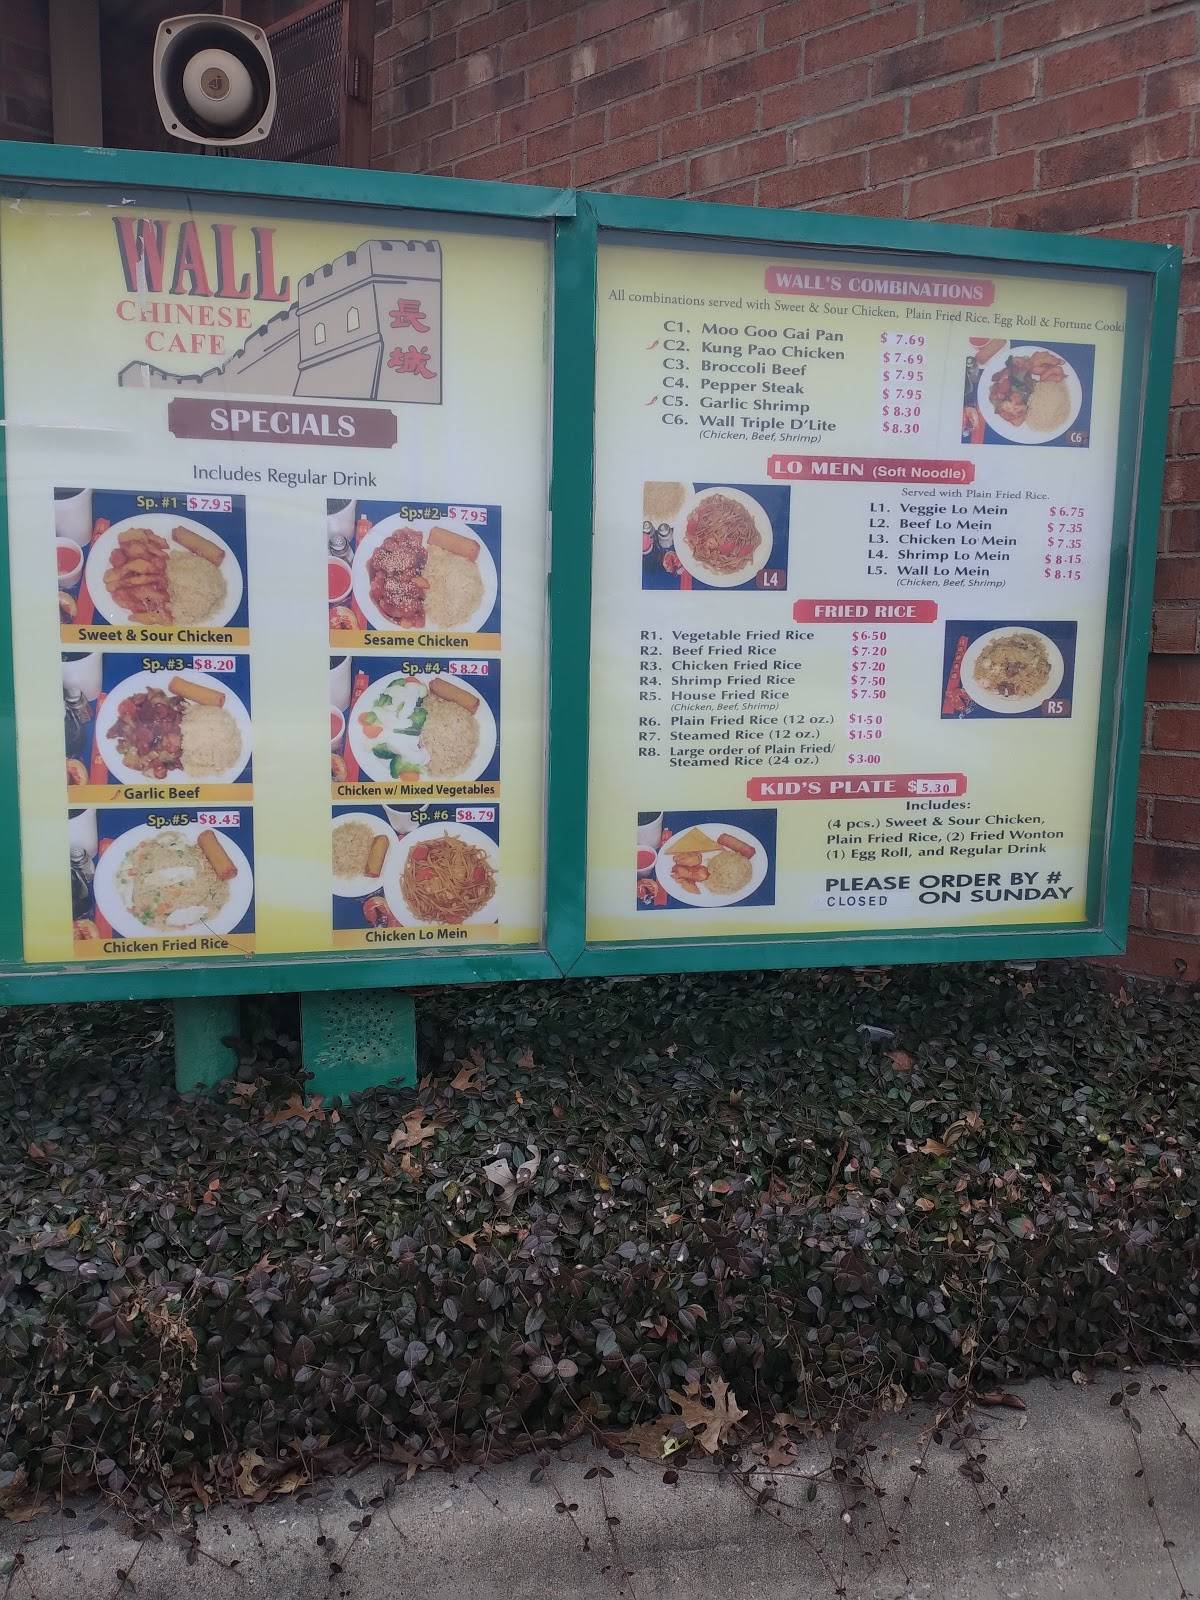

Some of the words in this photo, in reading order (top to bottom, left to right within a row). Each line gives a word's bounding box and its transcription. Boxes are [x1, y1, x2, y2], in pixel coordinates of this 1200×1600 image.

[113, 216, 290, 302] WALL
[776, 273, 842, 292] WALL'S
[849, 277, 983, 300] COMBINATIONS
[116, 300, 252, 330] CHINESE
[608, 289, 624, 301] All
[629, 290, 704, 306] combinations
[709, 298, 742, 309] served
[747, 299, 770, 310] with
[775, 300, 804, 313] Sweet
[824, 303, 848, 315] Sour
[852, 304, 899, 319] Chicken,
[906, 307, 932, 320] Plain
[936, 310, 961, 322] Fried
[965, 312, 990, 324] Rice,
[994, 313, 1012, 328] Egg
[1016, 315, 1036, 327] Roll
[1053, 317, 1091, 330] Fortune
[664, 321, 690, 333] C1.
[702, 323, 738, 336] Moo
[744, 325, 777, 338] Goo
[783, 327, 809, 340] Gai
[816, 329, 843, 341] Pan
[145, 330, 225, 355] CAFE
[664, 339, 690, 352] C2.
[702, 341, 742, 357] Kung
[748, 344, 776, 356] Pao
[782, 346, 845, 360] Chicken
[663, 358, 689, 370] C3.
[701, 360, 765, 374] Broccoli
[772, 363, 807, 376] Beef
[662, 395, 688, 407] C5.
[700, 397, 748, 410] Garlic
[754, 400, 809, 415] Shrimp
[210, 408, 355, 438] SPECIALS
[662, 414, 688, 425] C6.
[700, 415, 734, 427] Wall
[741, 417, 784, 432] Triple
[1070, 433, 1082, 443] C6
[193, 465, 262, 483] Includes
[267, 468, 327, 489] Regular
[333, 470, 376, 487] Drink
[774, 461, 802, 474] LO
[812, 462, 863, 476] MEIN
[873, 466, 906, 479] (Soft
[911, 468, 966, 480] Noodle)
[902, 488, 935, 497] Served
[939, 489, 962, 498] with
[966, 489, 992, 499] Plain
[996, 490, 1022, 500] Fried
[137, 496, 158, 510] Sp.
[870, 503, 890, 513] L1.
[900, 503, 946, 517] Veggie
[952, 505, 968, 514] Lo
[973, 505, 1008, 516] Mein
[868, 550, 888, 559] L4.
[898, 550, 948, 563] Shrimp
[954, 551, 969, 560] Lo
[975, 552, 1009, 561] Mein
[868, 566, 887, 575] L5.
[898, 565, 928, 576] Wall
[934, 566, 949, 576] Lo
[955, 567, 989, 577] Mein
[763, 573, 778, 587] L4
[814, 605, 868, 618] FRIED
[875, 605, 917, 618] RICE
[79, 629, 122, 640] Sweet
[141, 630, 172, 641] Sour
[178, 630, 232, 642] Chicken
[364, 634, 414, 646] Sesame
[418, 635, 468, 647] Chicken
[640, 631, 662, 641] R1.
[673, 630, 741, 642] Vegetable
[746, 630, 780, 640] Fried
[786, 631, 814, 640] Rice
[143, 658, 164, 672] Sp.
[167, 658, 184, 670] #3
[403, 662, 423, 676] Sp.
[425, 662, 440, 673] #4
[640, 691, 661, 701] R5.
[671, 691, 716, 700] House
[722, 691, 755, 700] Fried
[760, 690, 789, 699] Rice
[1048, 702, 1063, 714] R5
[639, 717, 660, 726] R6.
[671, 716, 704, 726] Plain
[710, 716, 744, 725] Fried
[750, 716, 778, 725] Rice
[784, 714, 805, 726] (12
[809, 714, 834, 725] oz.)
[639, 747, 660, 757] R8.
[670, 746, 704, 758] Large
[709, 745, 743, 755] order
[748, 744, 760, 754] of
[765, 744, 796, 754] Plain
[670, 757, 729, 768] Steamed
[735, 756, 763, 766] Rice
[768, 755, 790, 767] (24
[795, 754, 819, 766] oz.)
[124, 788, 164, 799] Garlic
[169, 786, 200, 799] Beef
[337, 785, 382, 796] Chicken
[384, 786, 397, 795] w/
[401, 785, 433, 795] Mixed
[436, 784, 495, 796] Vegetables
[760, 781, 822, 795] KID'S
[830, 780, 897, 794] PLATE
[906, 801, 971, 810] Includes:
[148, 814, 170, 829] Sp.
[172, 814, 189, 825] #5
[411, 811, 430, 824] Sp.
[433, 810, 448, 820] #6
[828, 818, 841, 831] (4
[846, 818, 881, 830] pcs.)
[885, 817, 927, 828] Sweet
[948, 816, 980, 826] Sour
[985, 814, 1045, 826] Chicken,
[827, 833, 862, 845] Plain
[868, 832, 903, 844] Fried
[908, 832, 942, 844] Rice,
[946, 831, 965, 843] (2)
[970, 831, 1005, 841] Fried
[1009, 830, 1064, 840] Wonton
[826, 849, 845, 861] (1)
[851, 848, 876, 861] Egg
[881, 847, 912, 859] Roll,
[918, 847, 945, 856] and
[950, 845, 1003, 859] Regular
[1008, 844, 1046, 855] Drink
[825, 876, 910, 892] PLEASE
[919, 873, 1000, 888] ORDER
[1011, 871, 1039, 885] BY
[1047, 871, 1062, 884] #
[827, 896, 887, 907] CLOSED
[919, 891, 960, 904] ON
[971, 886, 1074, 902] SUNDAY
[366, 931, 415, 943] Chicken
[419, 930, 433, 940] Lo
[438, 928, 467, 939] Mein
[103, 941, 158, 954] Chicken
[163, 940, 196, 951] Fried
[201, 938, 228, 949] Rice
